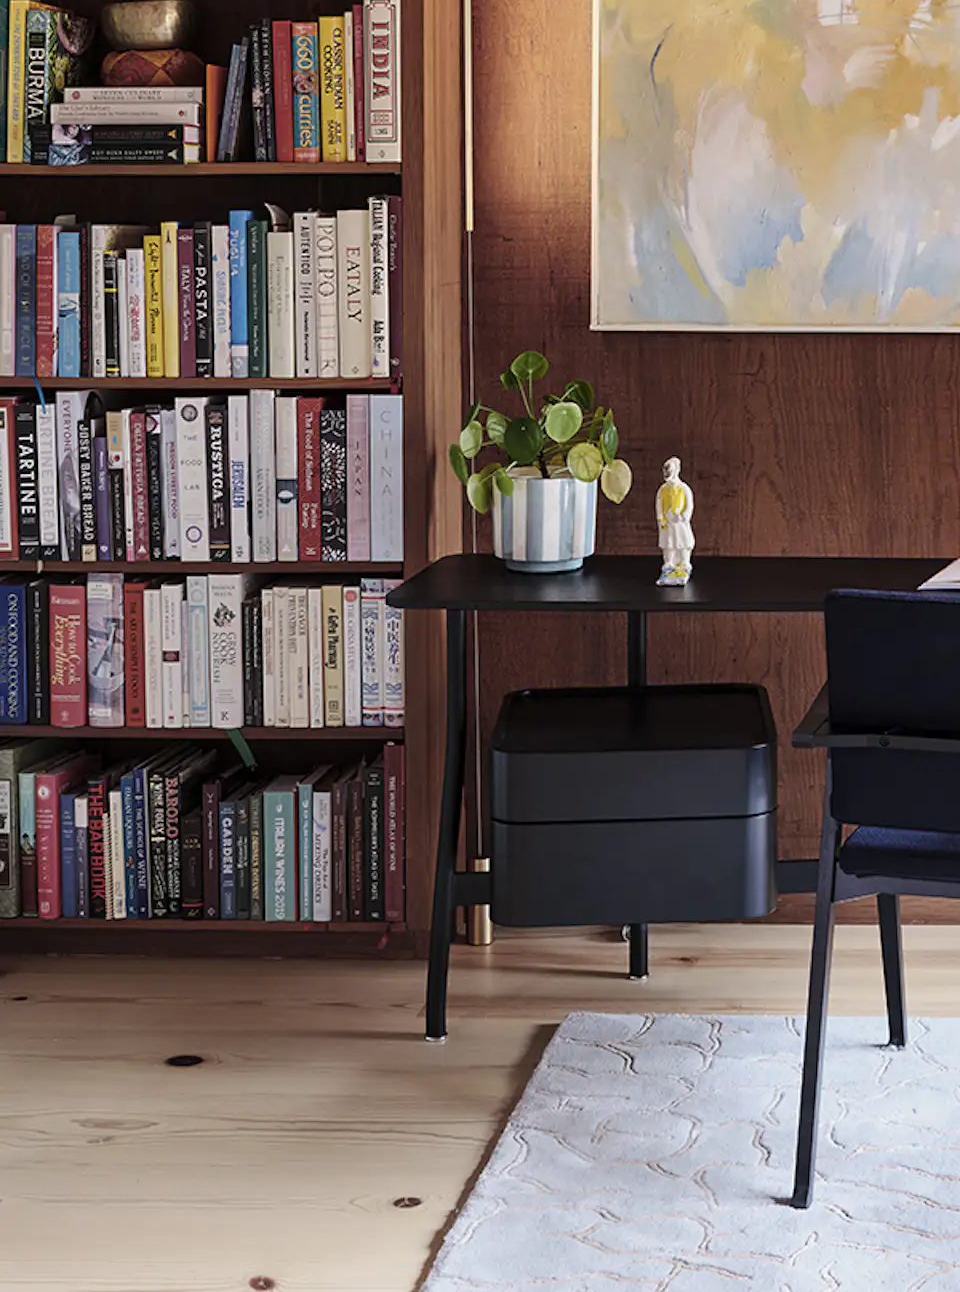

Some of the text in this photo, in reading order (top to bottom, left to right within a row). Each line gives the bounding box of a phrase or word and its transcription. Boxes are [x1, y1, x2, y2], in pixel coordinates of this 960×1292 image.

[28, 47, 45, 118] BURMA
[324, 44, 333, 94] COOKING
[334, 27, 345, 110] CLASSIC INDIAN
[372, 21, 390, 100] INDIA
[297, 35, 313, 149] 660 curries
[327, 119, 335, 145] SAHNI
[181, 264, 191, 292] ITALY
[230, 229, 239, 276] PUGLIA
[316, 224, 335, 298] POLPO
[370, 266, 385, 296] Cooking
[195, 266, 208, 320] PASTA
[345, 247, 362, 323] EATALY
[373, 320, 384, 334] Ada
[304, 411, 313, 429] The
[304, 430, 313, 449] Food
[18, 433, 35, 515] TARTINE
[79, 423, 95, 541] JOSEY BAKER BREAD
[210, 426, 225, 501] RUSTICA
[354, 440, 364, 498] JAPAN
[380, 409, 393, 498] CHINA
[231, 460, 245, 509] JERUSALEM
[41, 485, 55, 543] BREAD
[6, 593, 19, 718] ON FOOD AND COOKING
[52, 615, 69, 686] Everything
[66, 614, 81, 685] How to Cook
[212, 631, 220, 682] NOURISH
[219, 631, 228, 665] COOK
[227, 631, 237, 666] GROW
[165, 777, 179, 837] BAROLO
[88, 784, 105, 899] THE BAR BOOK
[221, 817, 234, 874] GARDEN
[274, 817, 286, 920] ITALIAN WINES 2019
[137, 859, 147, 889] WINE
